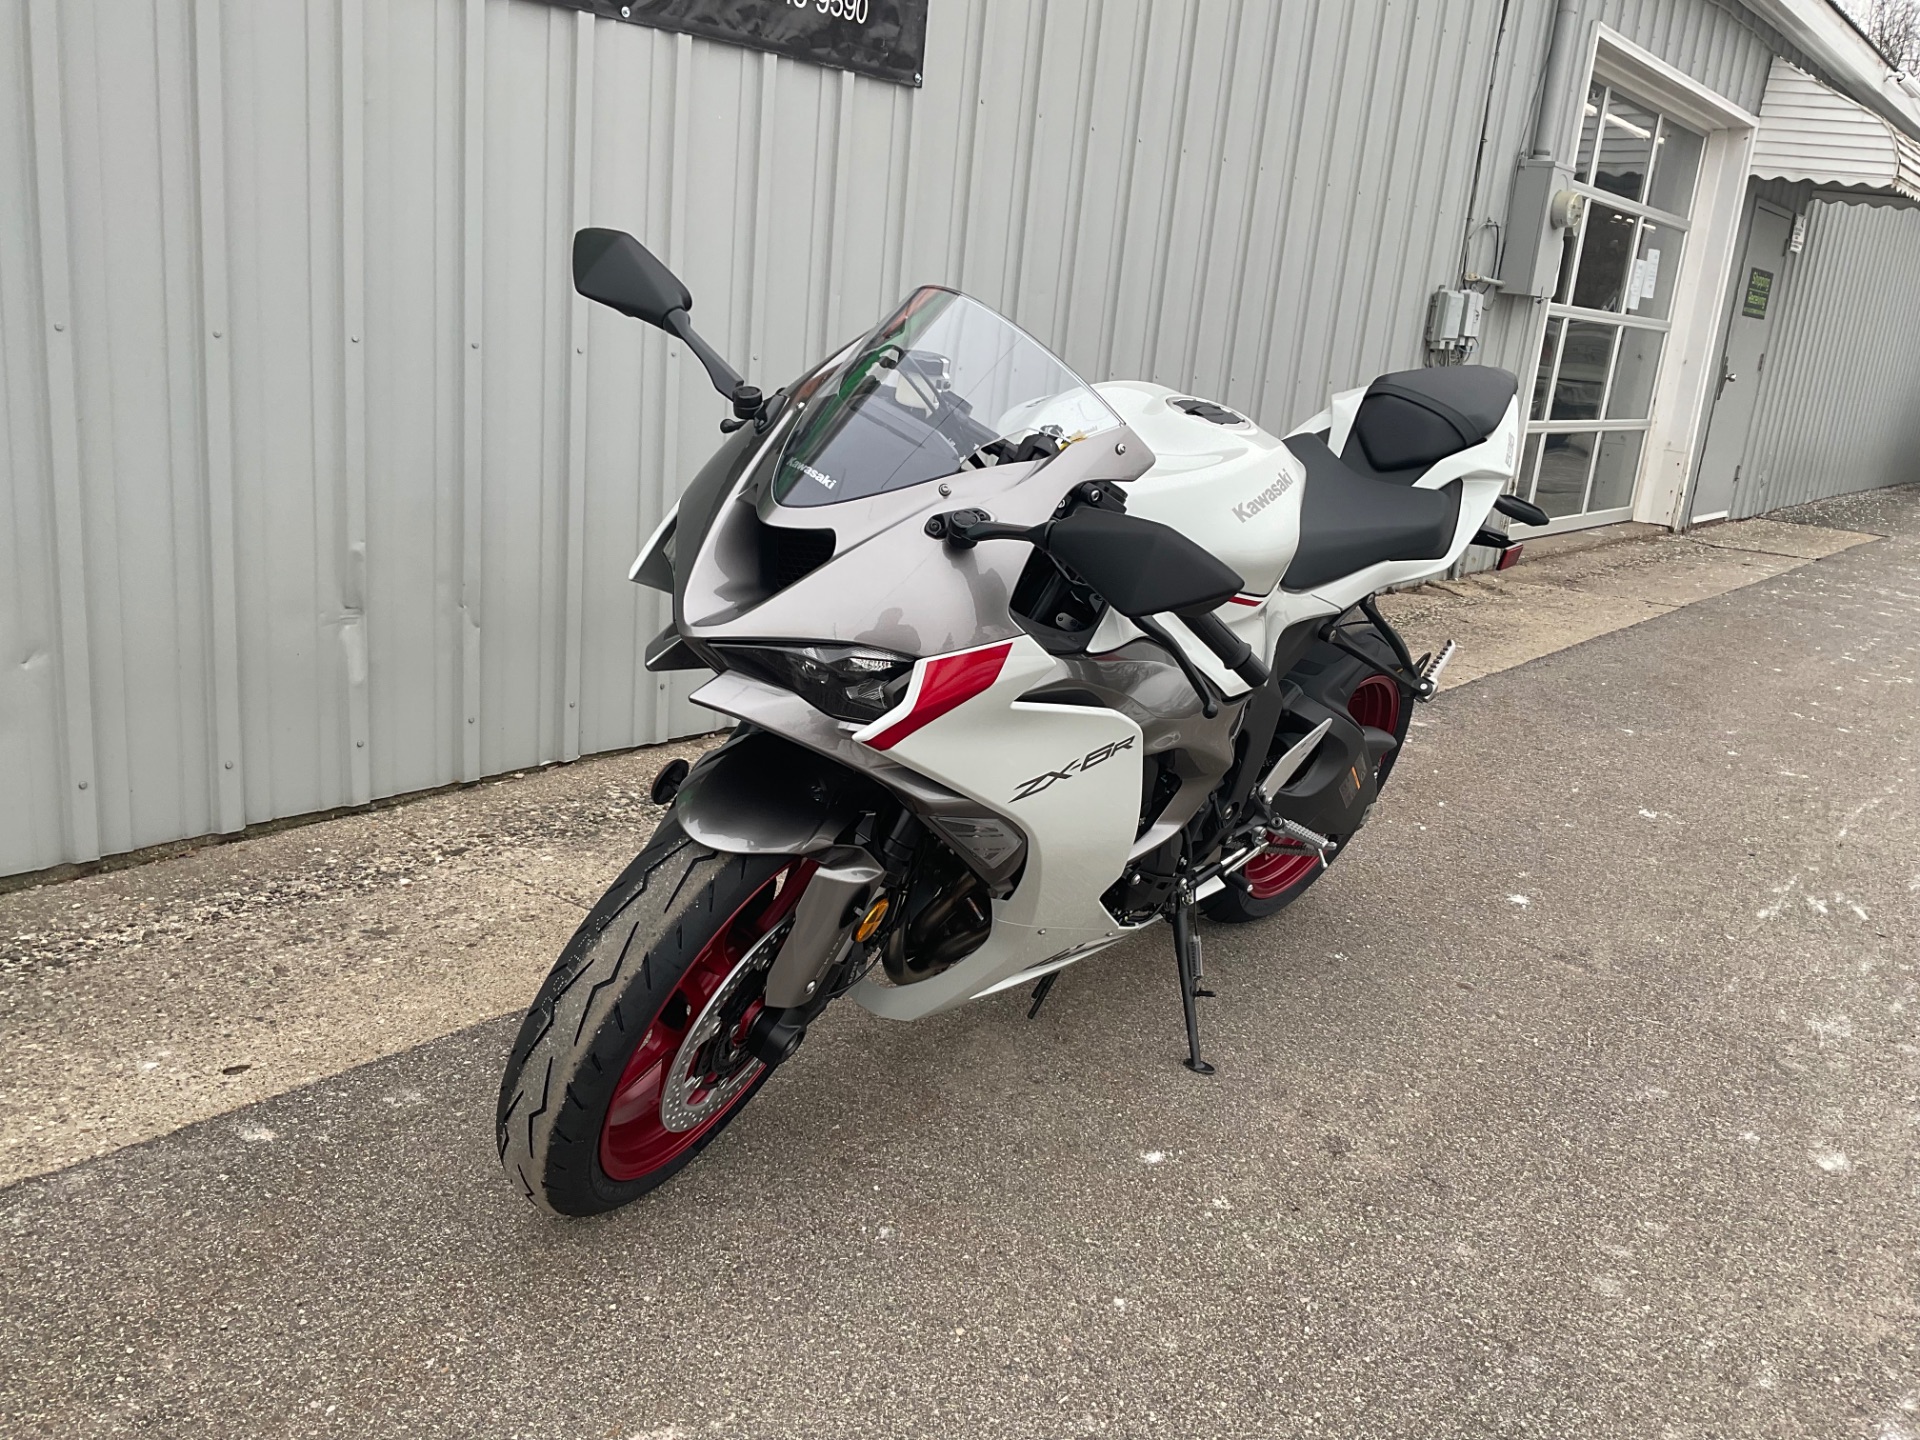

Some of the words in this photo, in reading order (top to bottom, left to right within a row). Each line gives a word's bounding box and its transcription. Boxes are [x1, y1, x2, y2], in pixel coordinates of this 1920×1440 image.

[786, 457, 837, 490] Kawasaki
[1231, 467, 1294, 524] Kawasaki
[1007, 735, 1136, 804] ZX-6R
